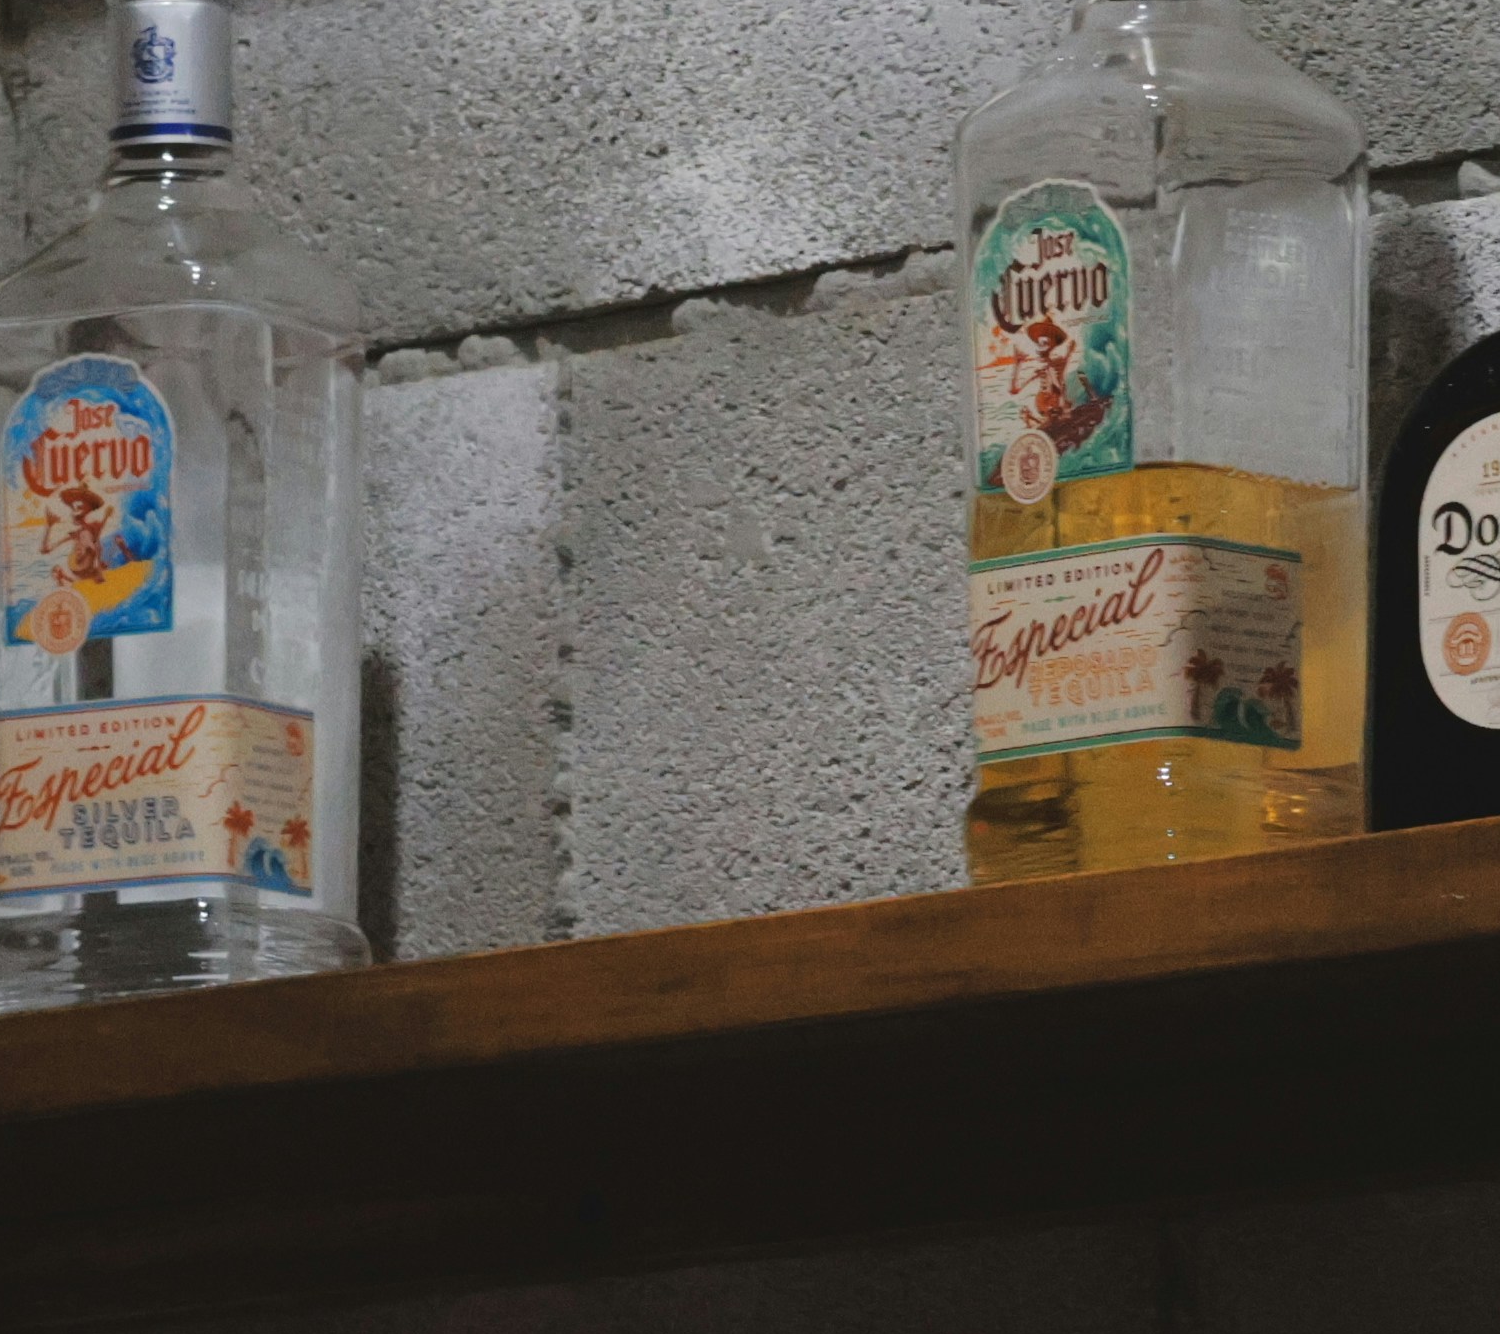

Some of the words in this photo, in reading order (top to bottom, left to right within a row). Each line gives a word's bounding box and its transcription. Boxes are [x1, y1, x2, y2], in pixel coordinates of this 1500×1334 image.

[1032, 227, 1074, 270] Jose
[992, 259, 1108, 333] Cuervo
[66, 398, 117, 438] Jose
[22, 427, 152, 497] Cuervo
[986, 572, 1056, 596] LIMITED
[1064, 561, 1135, 583] EDITION
[971, 547, 1165, 692] Especial
[1028, 670, 1157, 706] TEQUILA
[15, 723, 91, 742] LIMITED
[99, 715, 176, 735] EDITION
[71, 795, 181, 827] SILVER
[57, 817, 196, 850] TEQUILA
